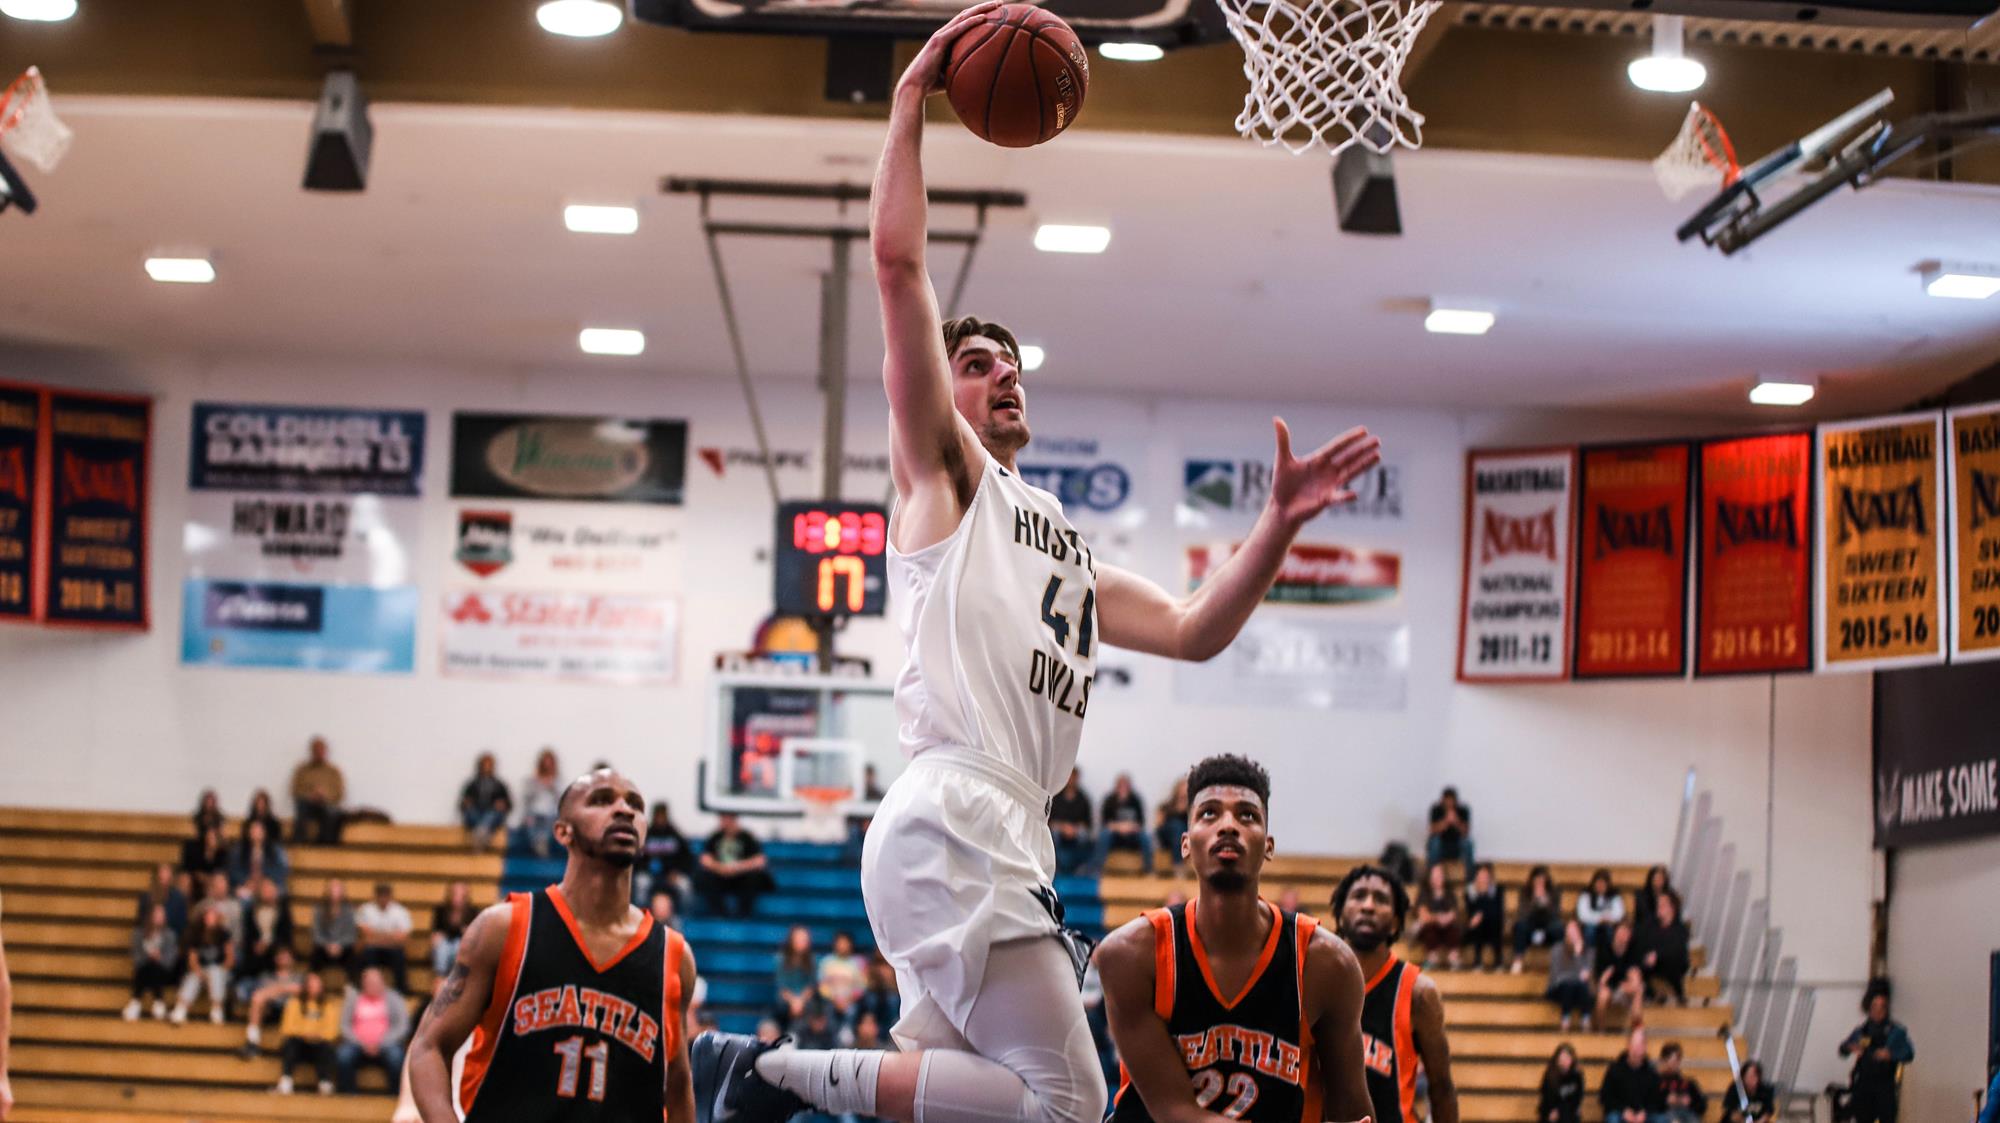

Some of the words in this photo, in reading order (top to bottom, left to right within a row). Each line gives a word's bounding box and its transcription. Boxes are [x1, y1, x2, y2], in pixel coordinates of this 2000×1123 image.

[206, 413, 403, 443] COLDWELL
[207, 436, 370, 471] BANKER
[1828, 431, 1931, 470] BASKETBALL
[1476, 467, 1566, 495] BASKETBALL
[232, 500, 348, 537] HOWARD
[1715, 492, 1798, 558] NAIA
[1838, 474, 1929, 547] NAIA
[1014, 505, 1096, 580] HUSTL
[1480, 504, 1559, 565] NAIA
[1595, 501, 1674, 561] NAIA
[1845, 548, 1918, 575] SWEET
[817, 554, 866, 613] 17
[1479, 575, 1553, 593] NATIONAL
[1837, 576, 1928, 608] SIXTEEN
[1041, 574, 1095, 660] 41
[1472, 602, 1560, 622] CHAMPIONS
[1839, 612, 1930, 651] 2015-16
[1478, 634, 1553, 665] 2011-12
[1588, 629, 1671, 661] 2013-14
[1711, 623, 1798, 661] 2014-15
[1028, 648, 1092, 720] OWLS
[1900, 769, 1945, 825] MAKE
[1948, 758, 1998, 818] SOME
[513, 984, 660, 1065] SEATTLE
[553, 1035, 610, 1103] 11
[1174, 1024, 1301, 1086] EATTLE
